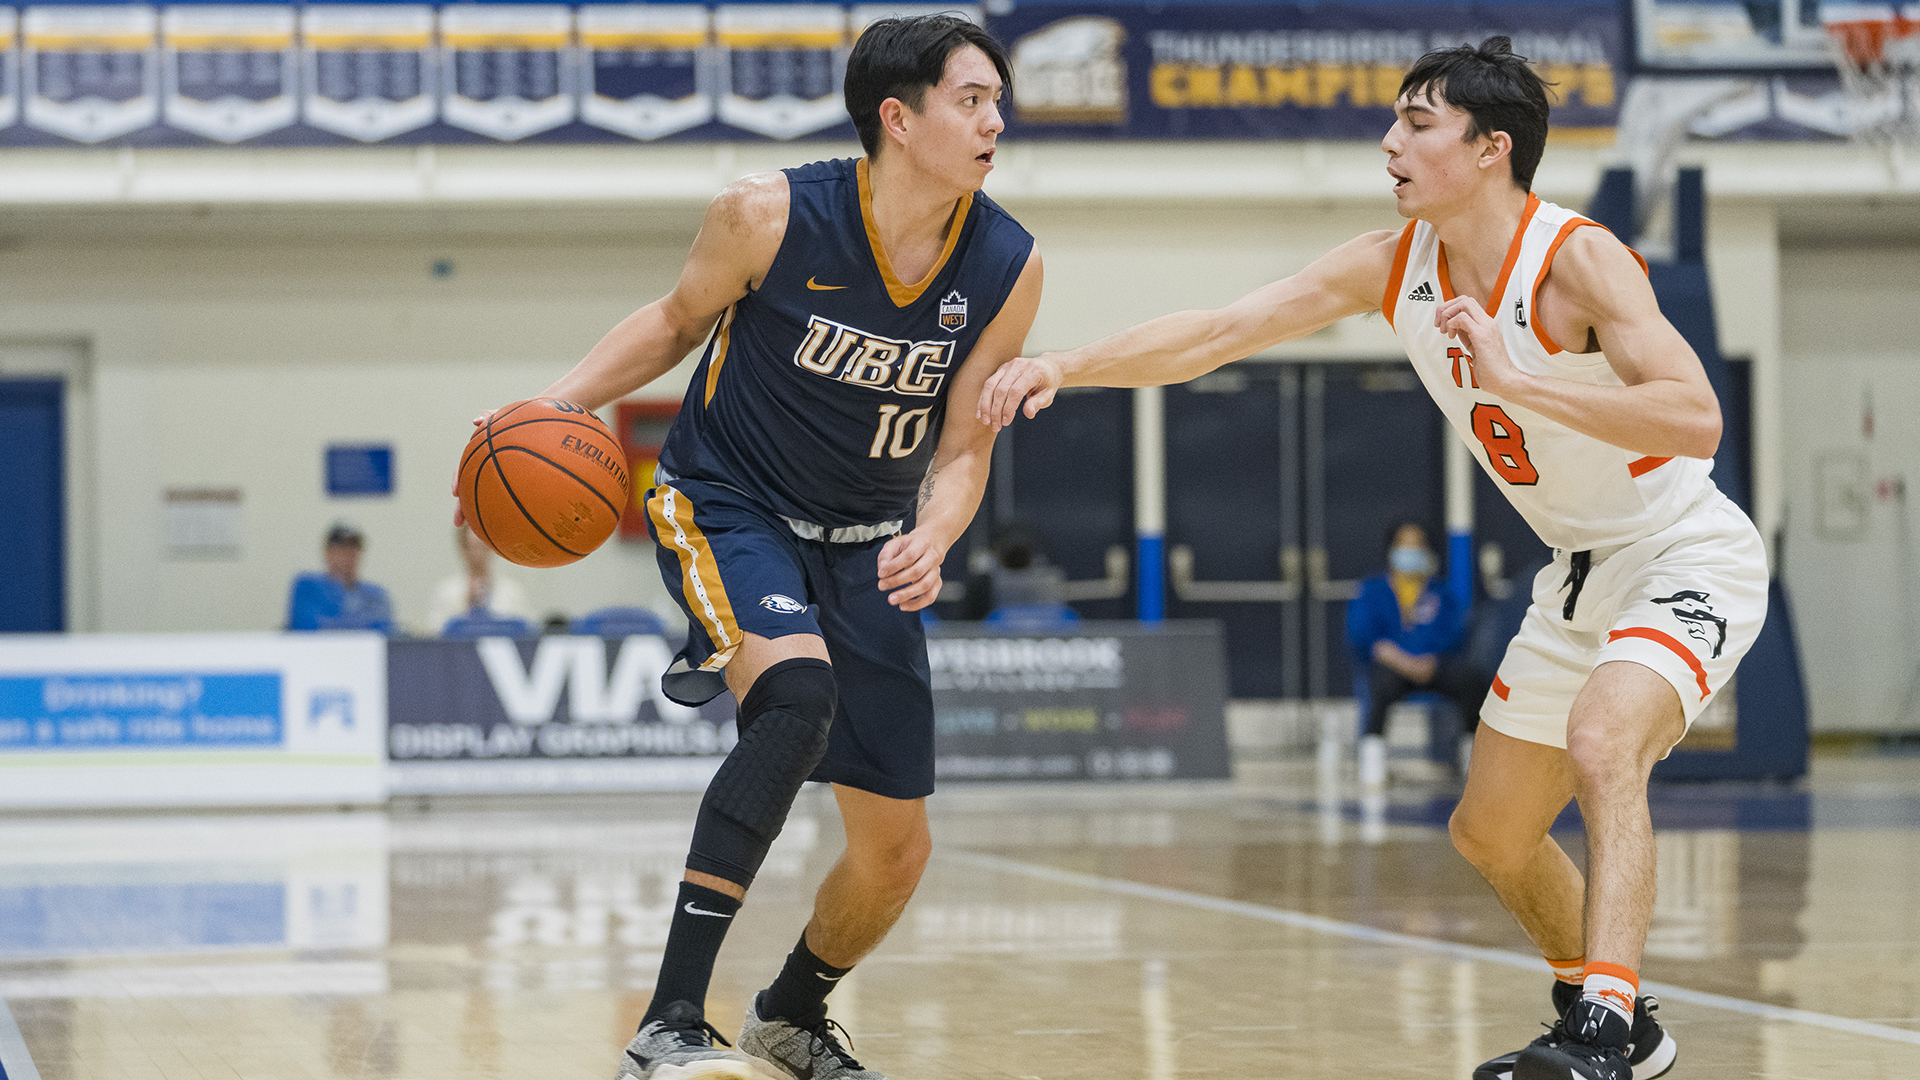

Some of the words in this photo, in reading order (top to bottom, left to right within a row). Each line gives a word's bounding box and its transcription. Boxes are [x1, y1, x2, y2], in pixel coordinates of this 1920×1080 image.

[1150, 64, 1613, 107] CHAMPIOPS
[942, 305, 965, 313] CANADA
[942, 314, 964, 326] WEST
[1408, 293, 1435, 302] adidas
[797, 317, 955, 396] UBC
[868, 403, 934, 459] 10
[1470, 402, 1540, 486] 8
[477, 635, 698, 726] VIA
